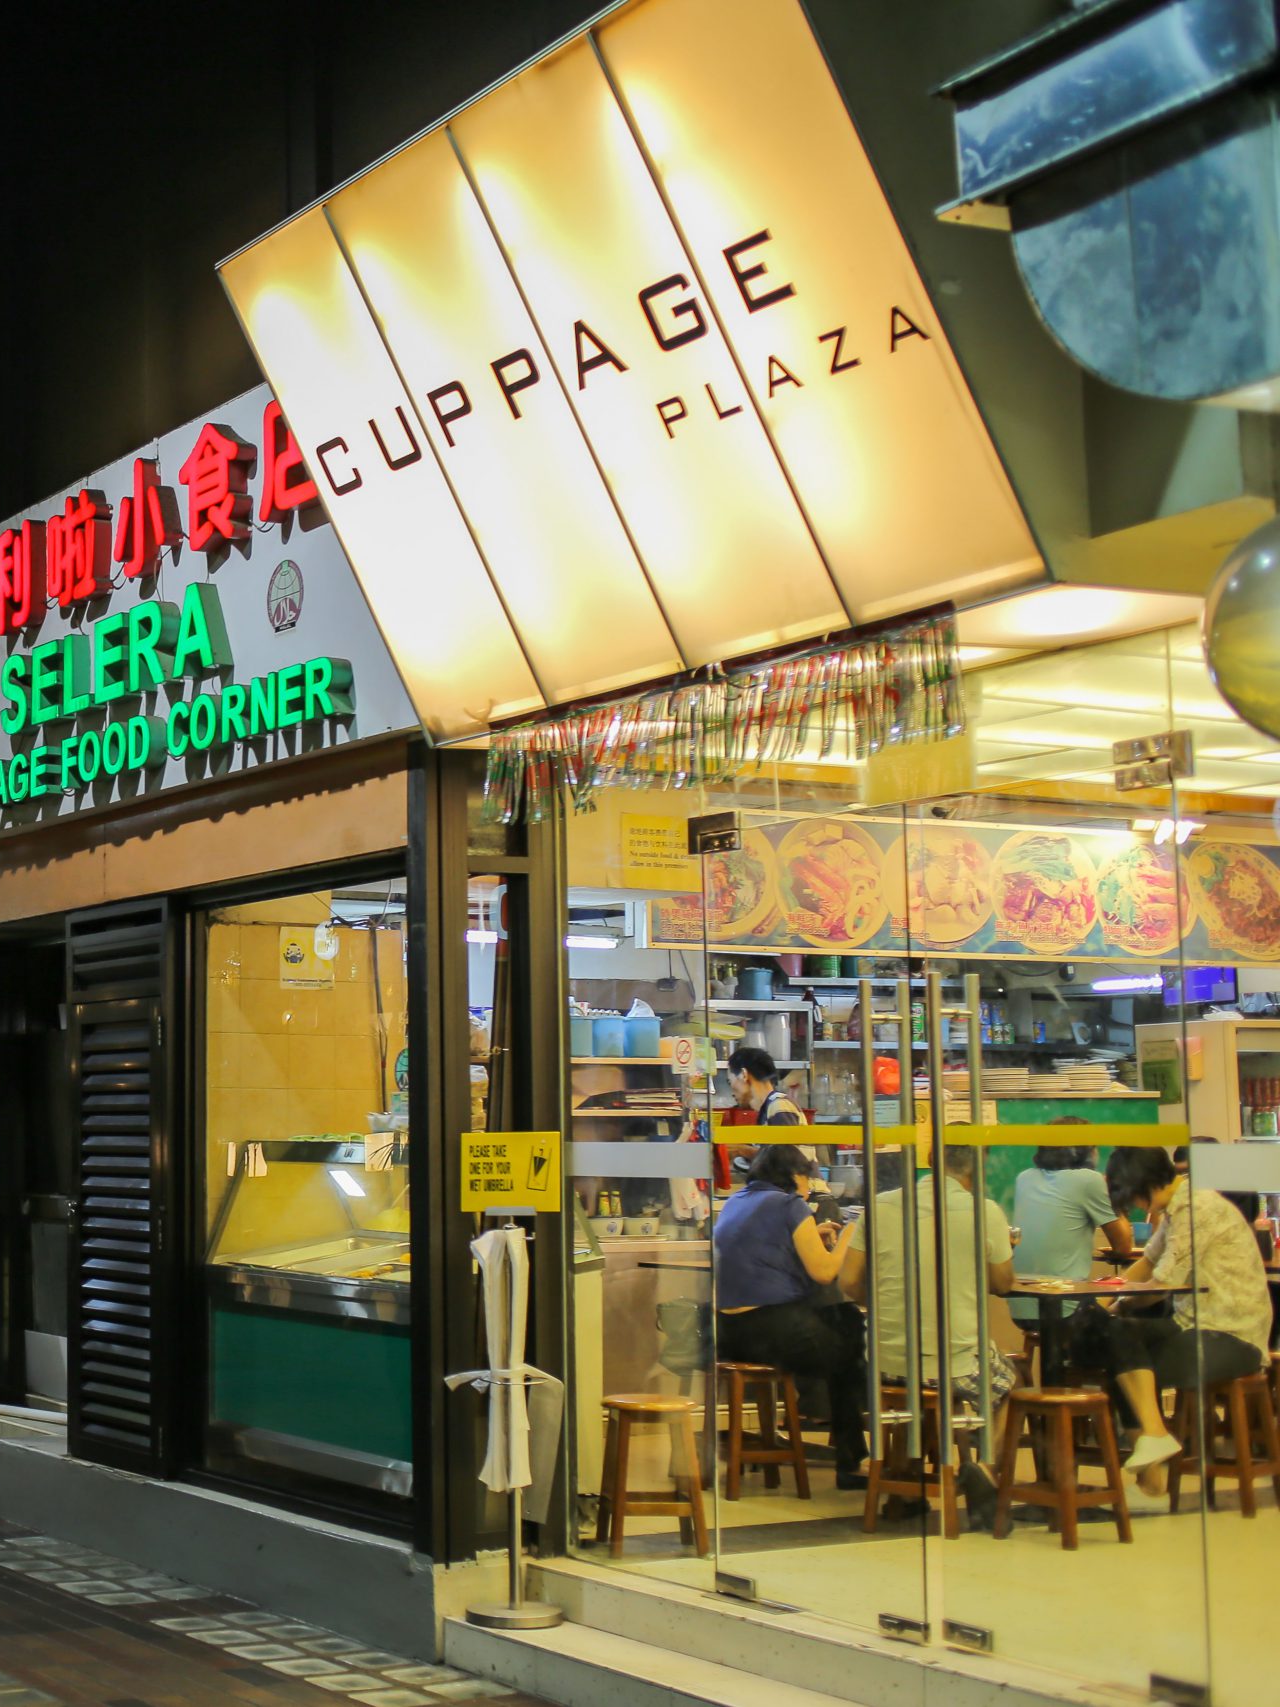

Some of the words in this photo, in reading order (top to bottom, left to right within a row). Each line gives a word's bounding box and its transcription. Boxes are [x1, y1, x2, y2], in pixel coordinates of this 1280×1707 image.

[316, 228, 798, 496] CUPPAGE
[655, 306, 931, 439] PLAZA
[0, 583, 220, 735] SELERA
[60, 715, 152, 791] FOOD
[166, 656, 335, 758] CORNER
[469, 1144, 490, 1158] PLEASE
[492, 1144, 507, 1158] TAKE
[469, 1162, 481, 1175] ONE
[482, 1161, 494, 1175] FOR
[496, 1161, 511, 1175] YOUR
[469, 1179, 482, 1192] WET
[483, 1179, 514, 1192] UMBRELLA
